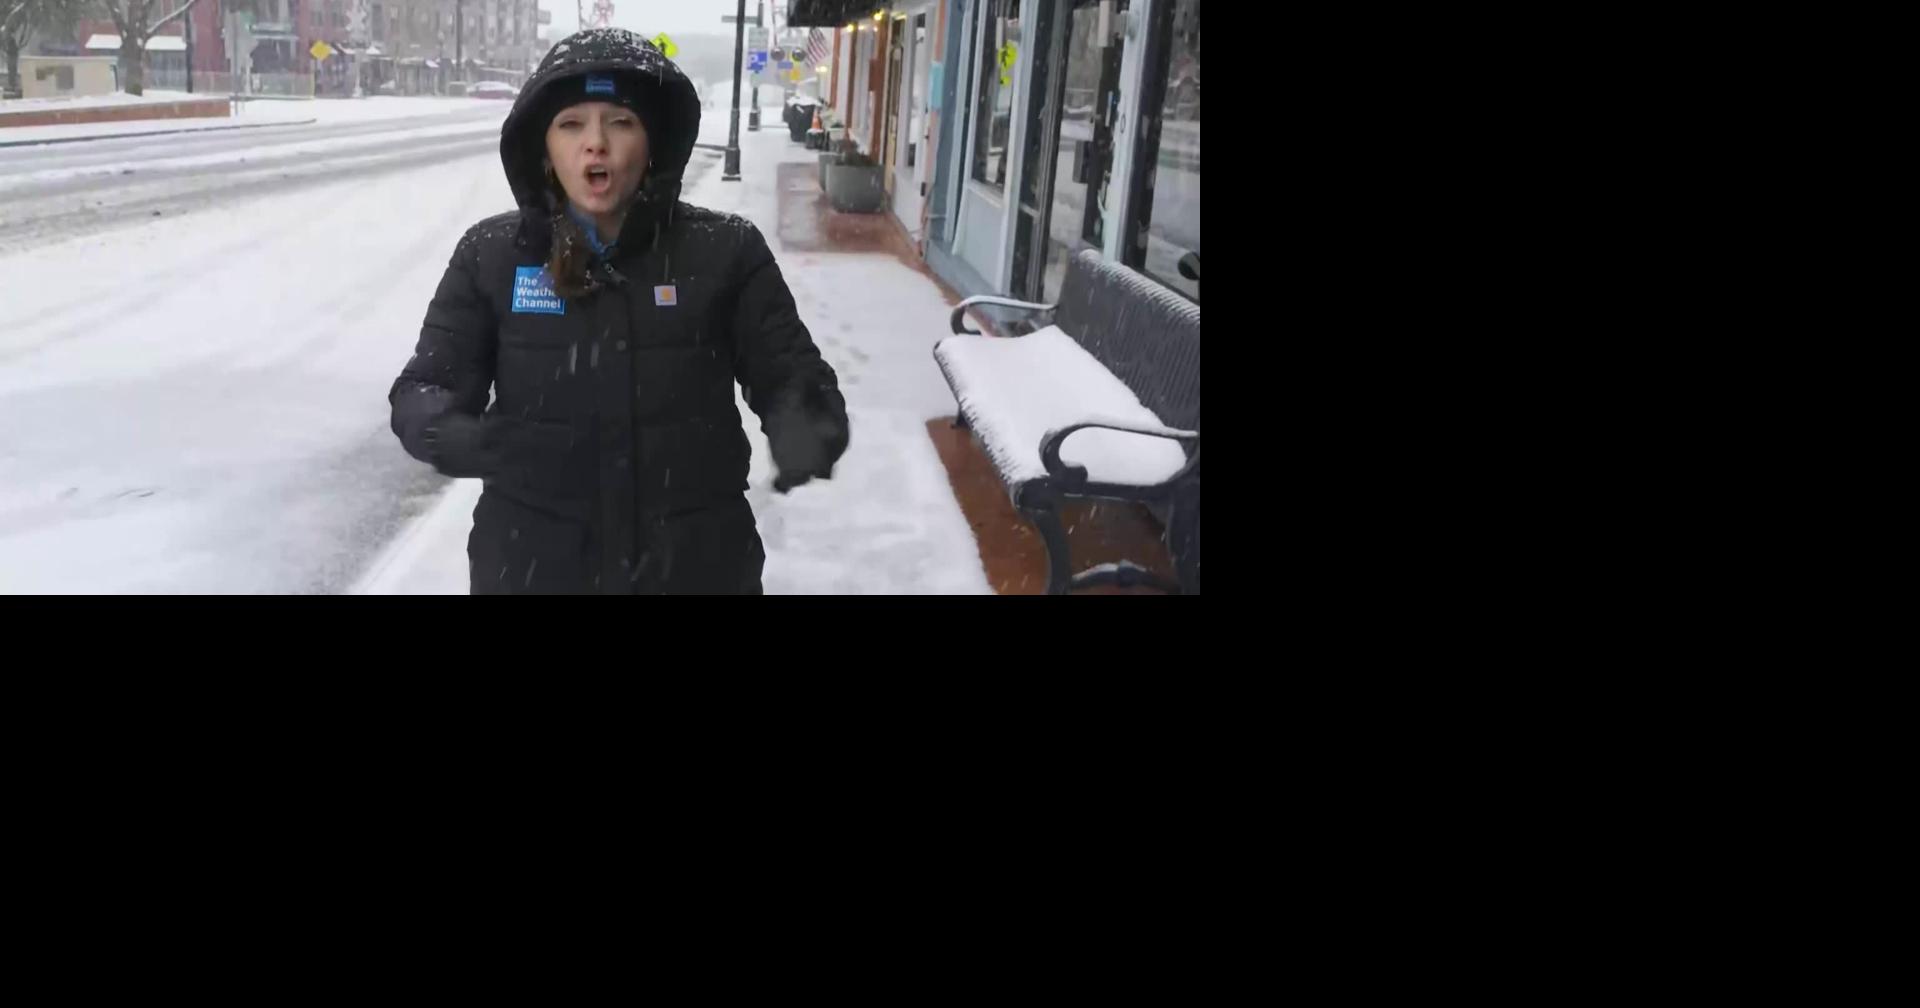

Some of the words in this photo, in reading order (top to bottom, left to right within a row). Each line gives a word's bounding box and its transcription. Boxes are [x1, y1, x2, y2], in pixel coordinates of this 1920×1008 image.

[518, 276, 538, 286] The
[517, 287, 556, 297] Weath
[515, 298, 561, 309] Channel
